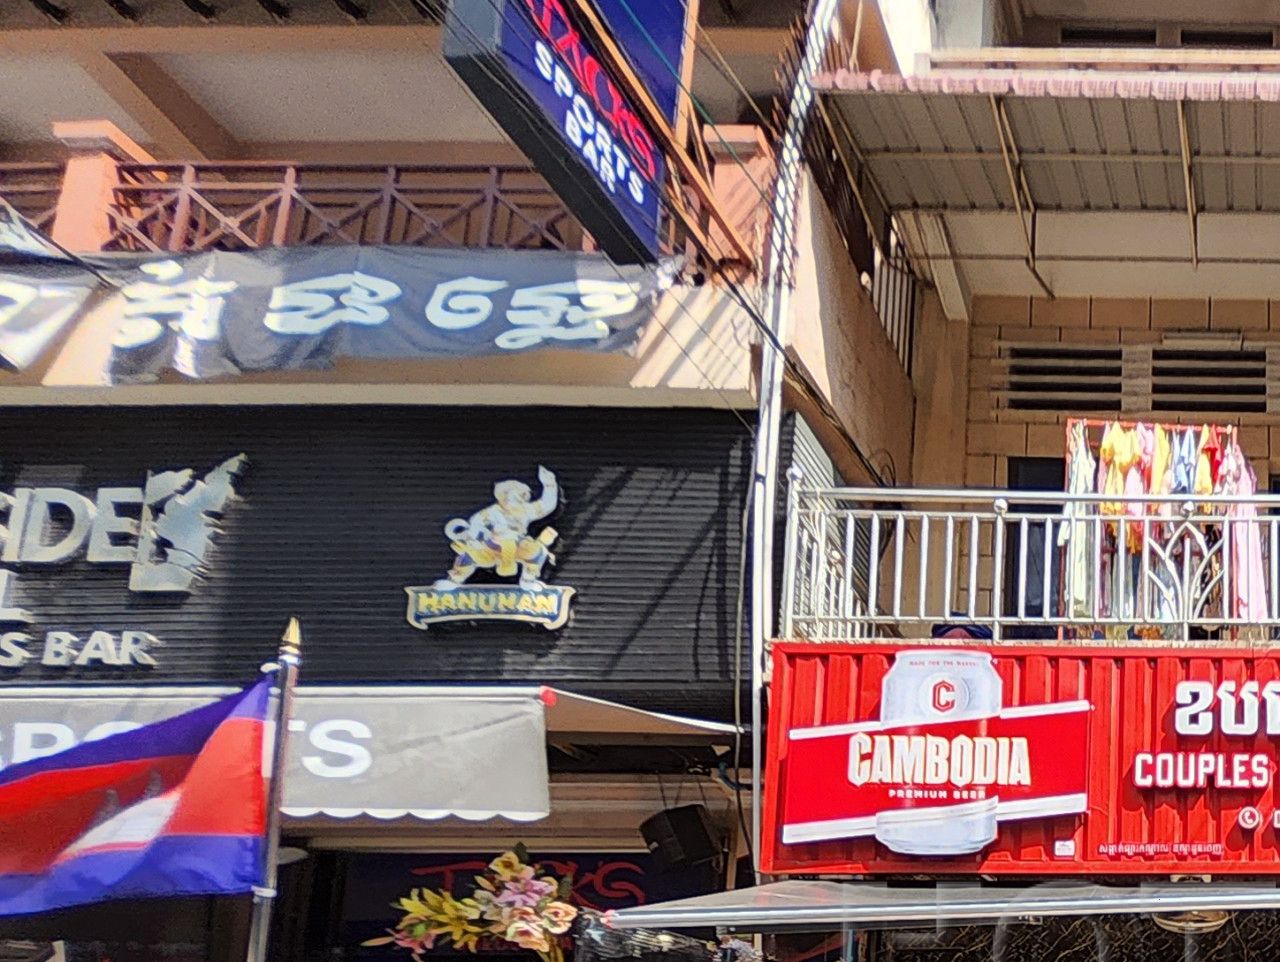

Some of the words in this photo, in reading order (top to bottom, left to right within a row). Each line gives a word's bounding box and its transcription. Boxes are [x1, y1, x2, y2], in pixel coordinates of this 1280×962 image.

[533, 39, 644, 205] SPORTS
[566, 109, 616, 194] BAR
[41, 630, 162, 666] BAR
[932, 679, 956, 714] C
[847, 731, 1032, 788] CAMBODIA
[1134, 752, 1272, 789] COUPLES
[888, 788, 948, 800] PREMIUM
[953, 789, 987, 800] BEER
